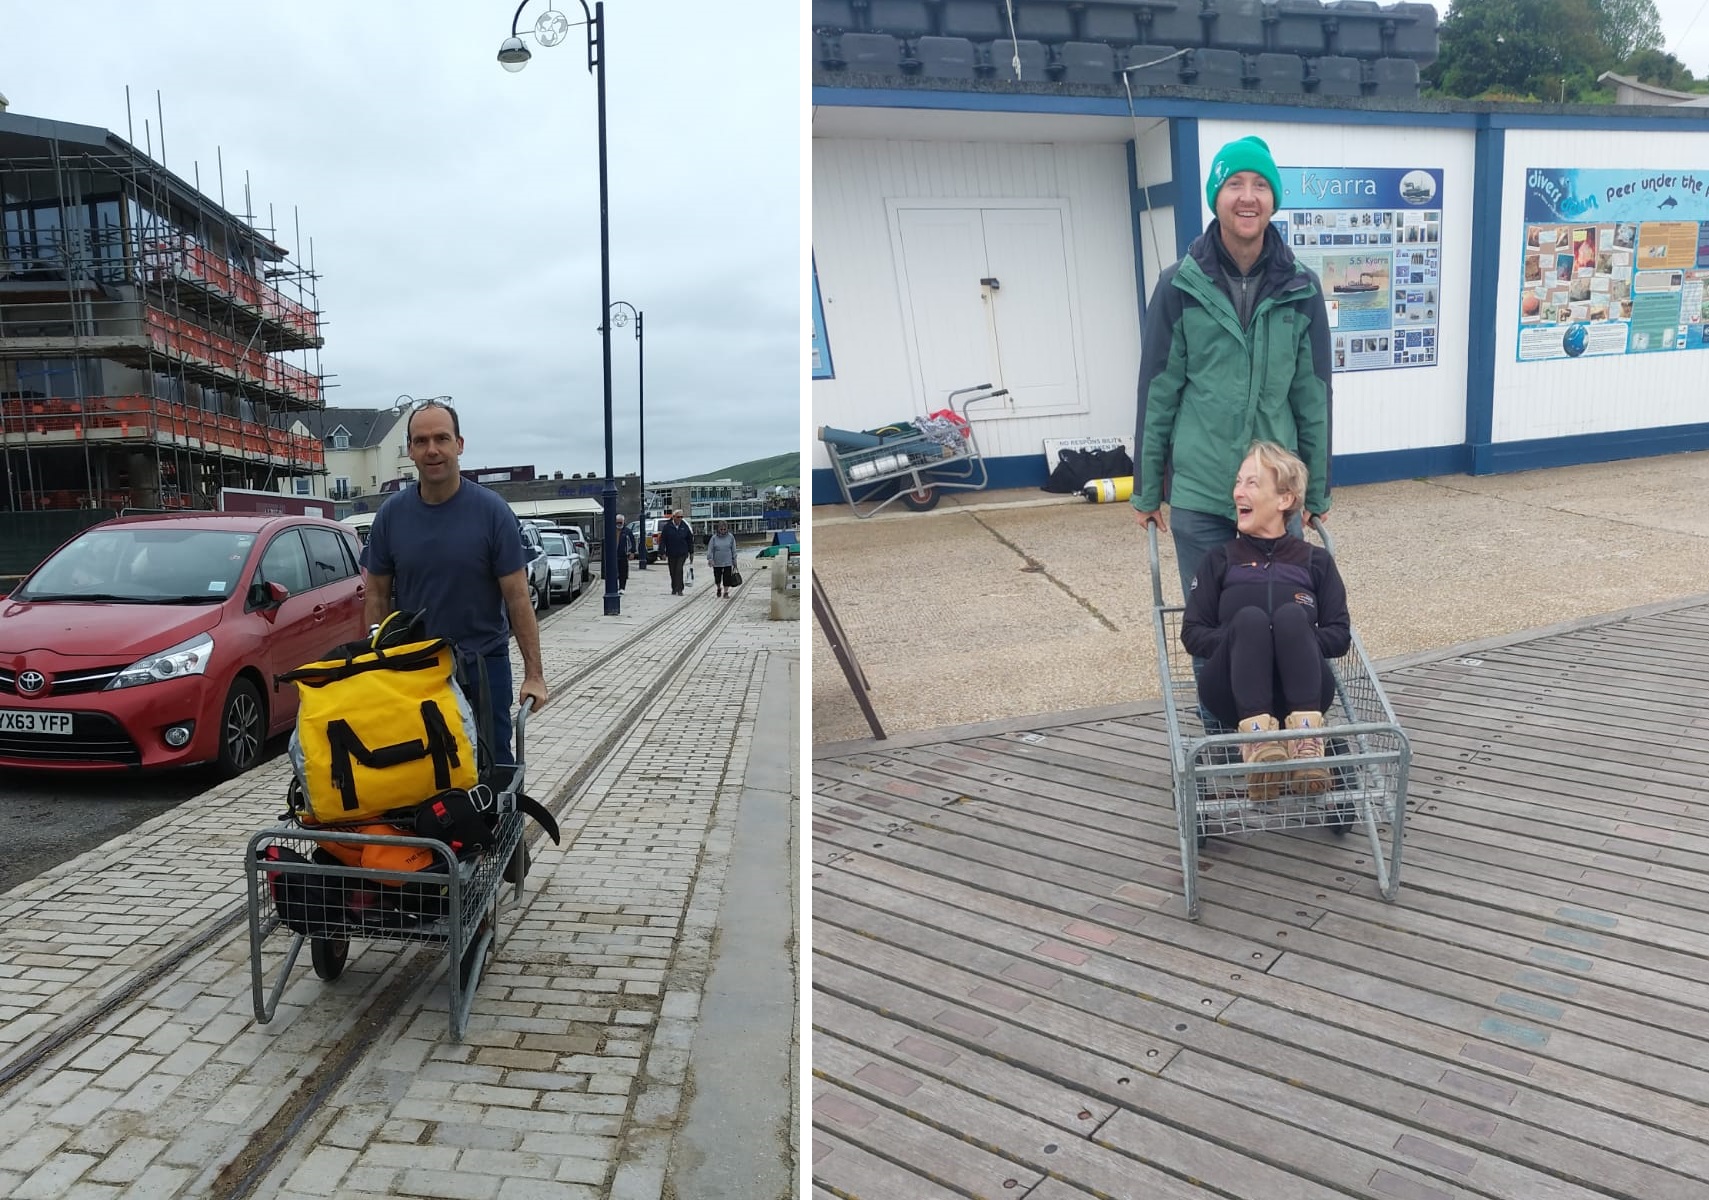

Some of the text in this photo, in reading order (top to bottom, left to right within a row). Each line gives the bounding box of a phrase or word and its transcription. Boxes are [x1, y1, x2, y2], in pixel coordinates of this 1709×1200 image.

[1301, 172, 1377, 200] Kyarra
[1528, 169, 1562, 203] divers
[1606, 181, 1637, 203] peer
[1641, 173, 1678, 193] under
[1681, 174, 1704, 194] the
[39, 714, 70, 732] YFP
